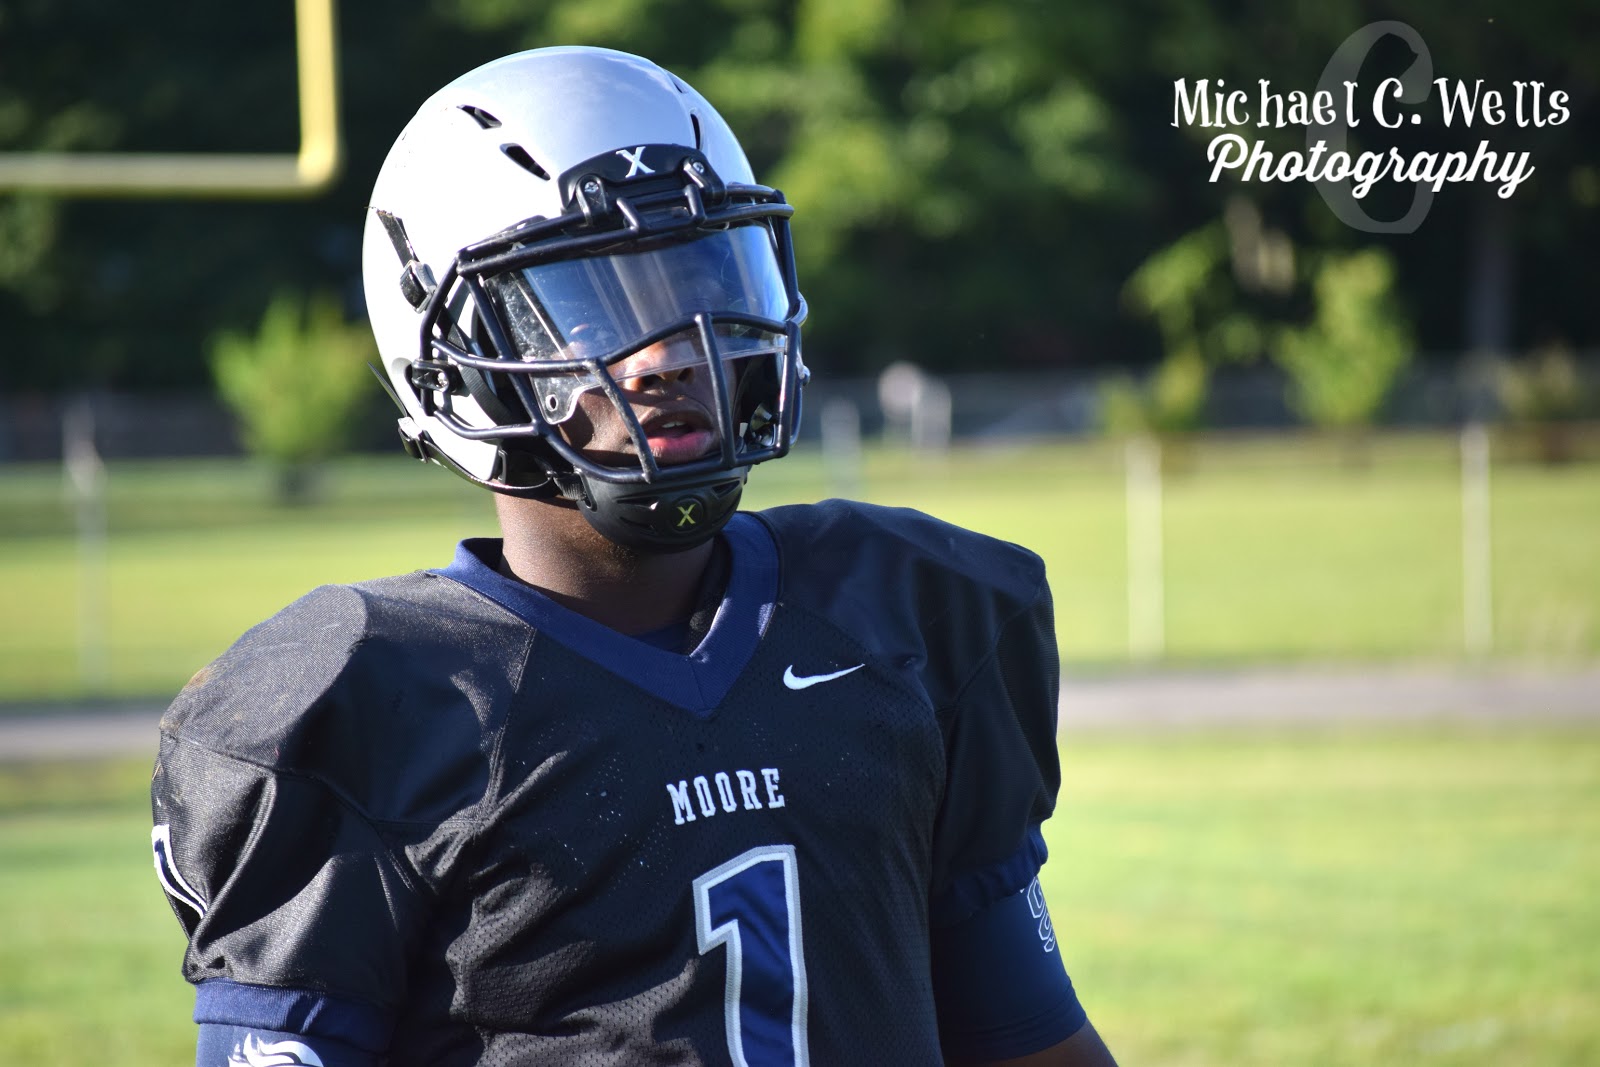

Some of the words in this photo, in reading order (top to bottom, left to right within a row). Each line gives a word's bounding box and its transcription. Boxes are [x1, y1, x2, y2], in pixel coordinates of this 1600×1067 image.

[616, 146, 656, 178] X
[677, 503, 696, 527] X
[666, 768, 785, 825] MOORE
[692, 844, 810, 1067] 1
